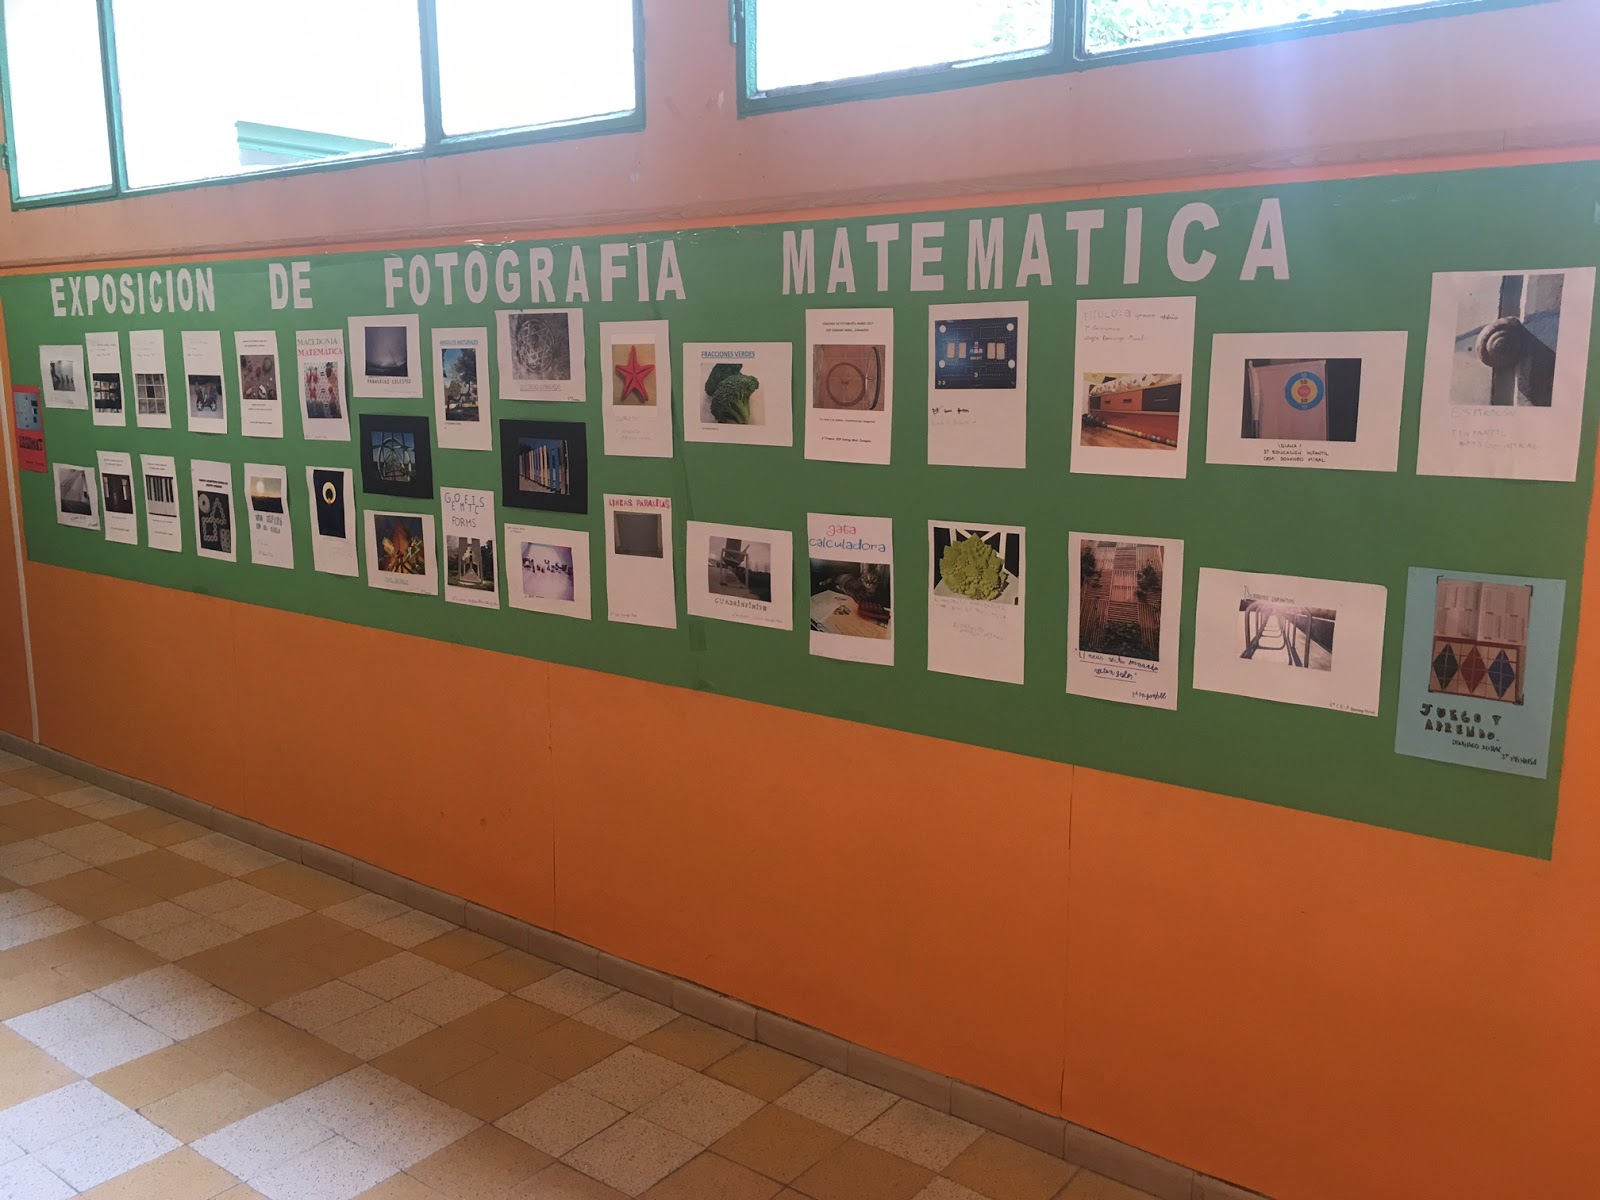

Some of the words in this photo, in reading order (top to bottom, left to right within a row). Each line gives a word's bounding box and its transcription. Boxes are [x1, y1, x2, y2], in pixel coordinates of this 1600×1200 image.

[50, 267, 216, 317] EXPOSICION
[269, 260, 313, 310] DE
[384, 240, 686, 308] FOTOGRAFIA
[782, 198, 1290, 296] MATEMATICA
[701, 351, 734, 359] FRACCIONES
[734, 351, 755, 359] VERDES
[451, 516, 477, 528] FORMS
[826, 524, 857, 537] gata
[808, 537, 886, 553] calculadora
[1420, 703, 1482, 723] JUEGO
